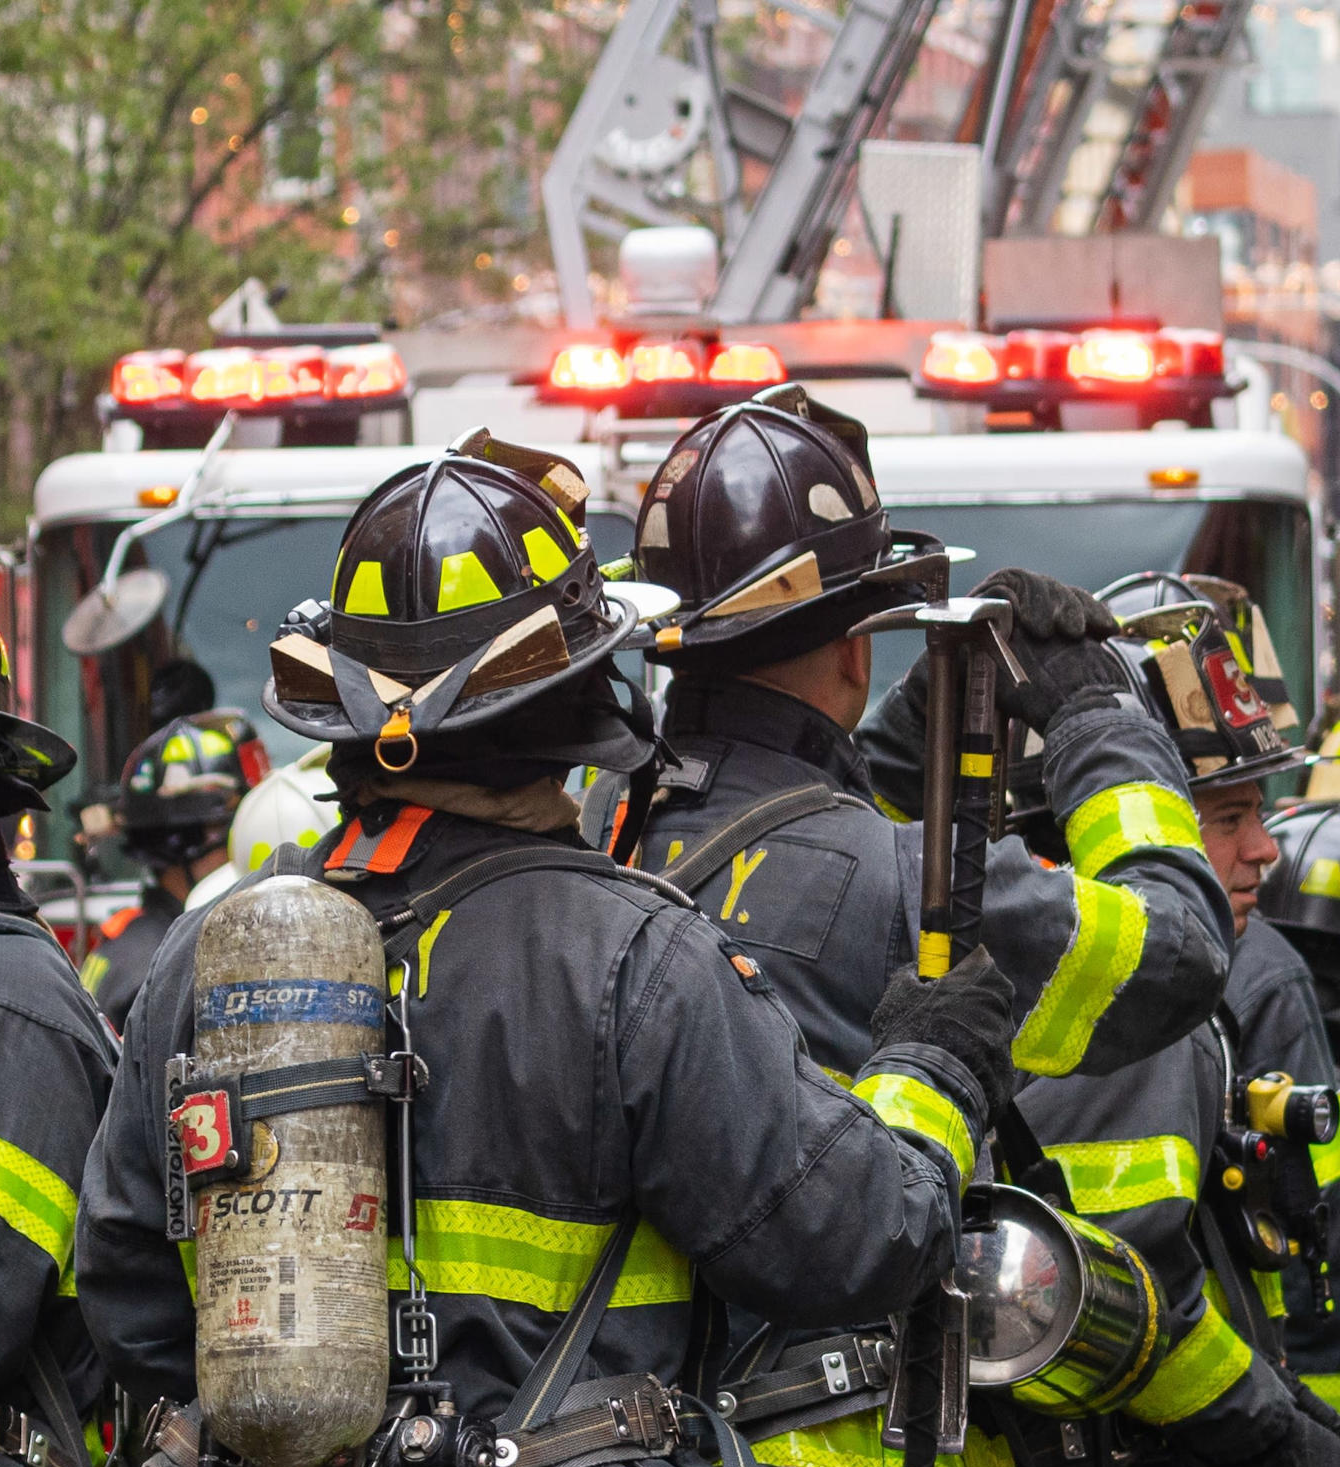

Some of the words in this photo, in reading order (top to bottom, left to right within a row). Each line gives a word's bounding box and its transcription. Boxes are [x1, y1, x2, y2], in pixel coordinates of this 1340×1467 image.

[251, 988, 318, 1005] SCOTT
[180, 1105, 221, 1160] 3
[213, 1189, 323, 1218] SCOTT
